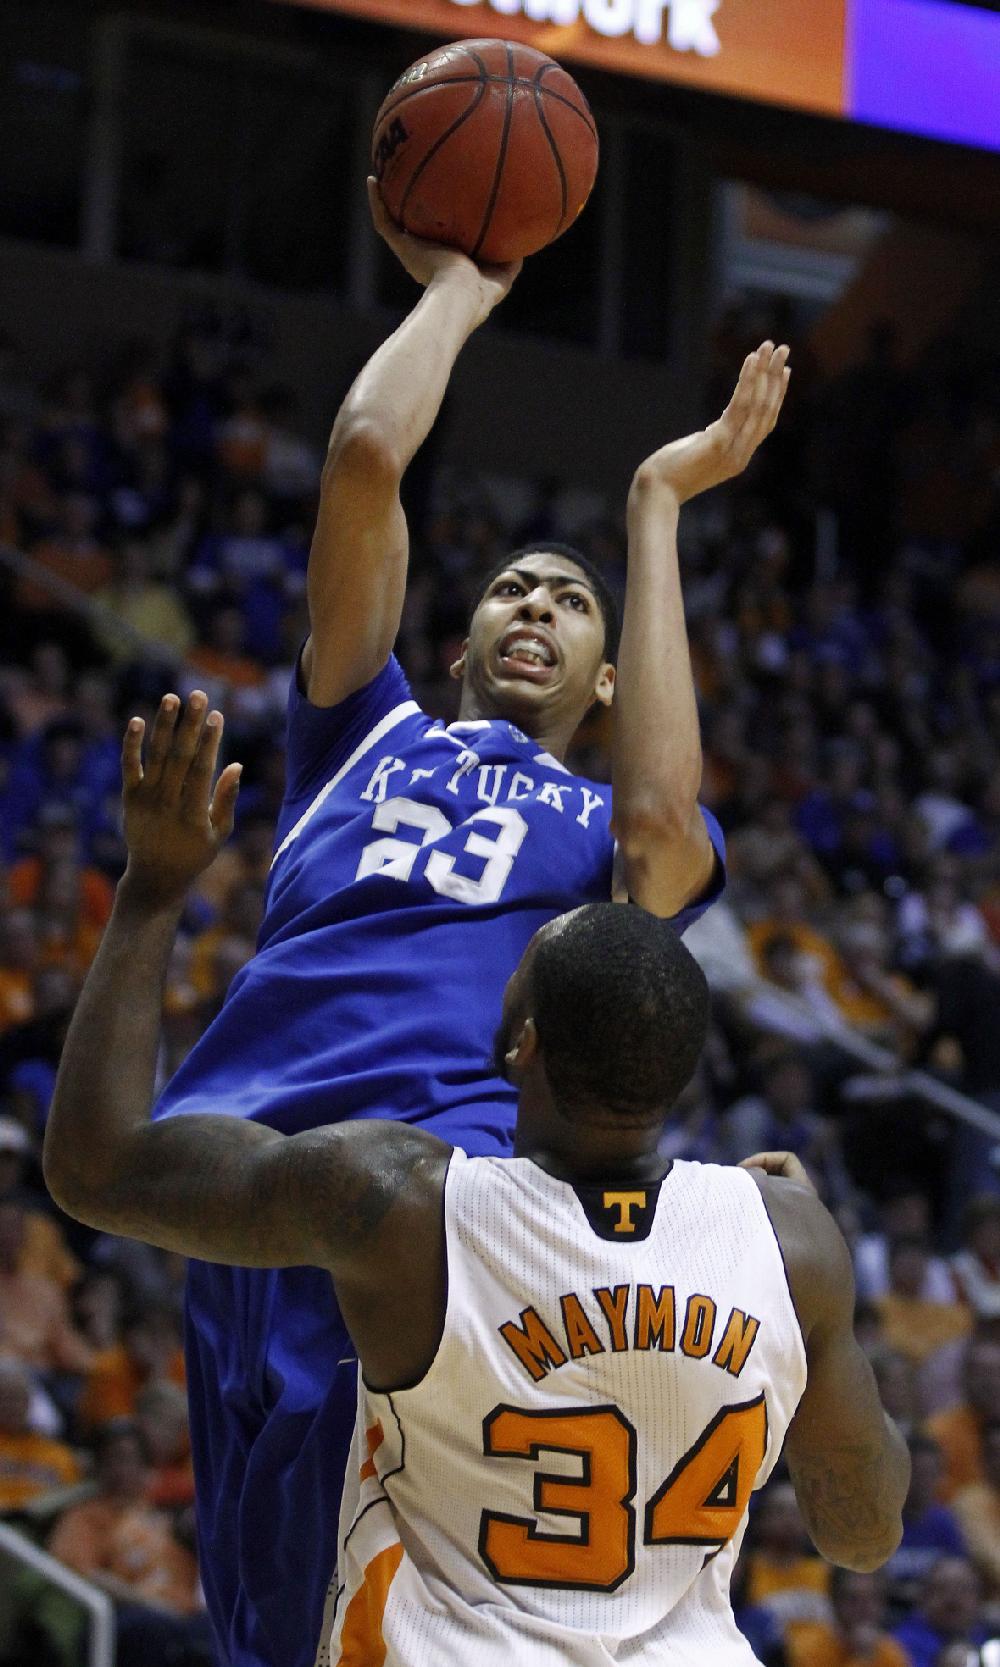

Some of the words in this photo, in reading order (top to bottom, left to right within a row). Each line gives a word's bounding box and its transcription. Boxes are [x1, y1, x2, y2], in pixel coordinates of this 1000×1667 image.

[360, 750, 604, 829] KTUCKY
[355, 797, 528, 905] 23
[603, 1191, 646, 1233] T
[498, 1284, 761, 1383] MAYMON
[478, 1391, 768, 1593] 34
